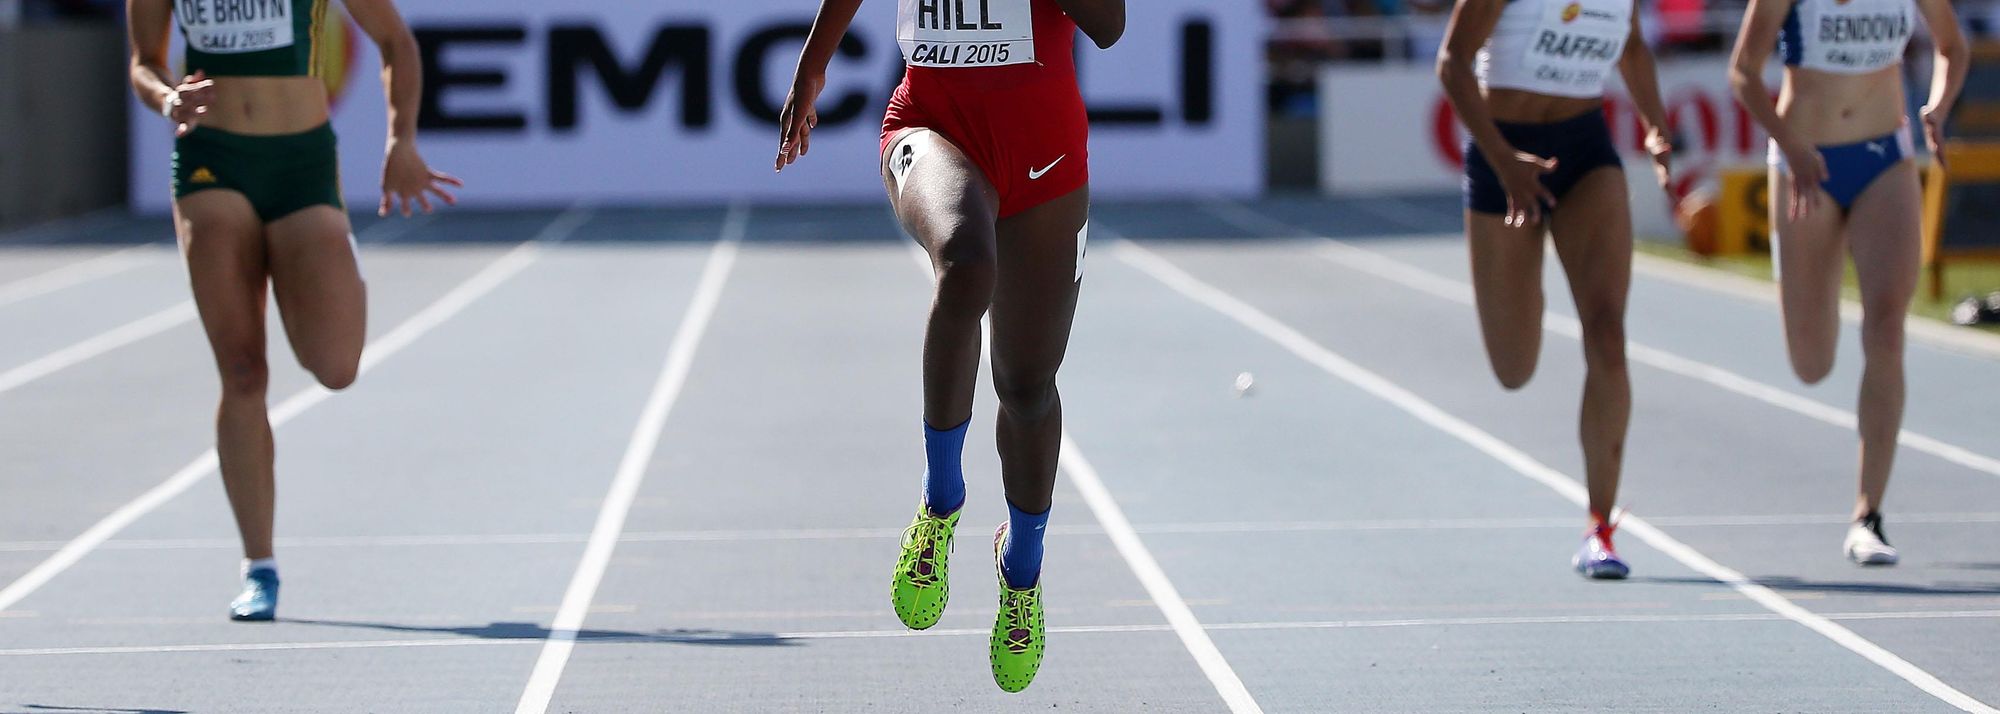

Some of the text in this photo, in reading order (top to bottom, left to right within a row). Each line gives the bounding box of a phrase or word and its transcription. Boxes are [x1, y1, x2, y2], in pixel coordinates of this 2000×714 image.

[181, 0, 285, 25] DE BRUYN
[918, 0, 1002, 30] HILL
[201, 33, 237, 48] CALI
[911, 43, 1010, 64] CALI 2015
[411, 24, 1212, 130] EMCI
